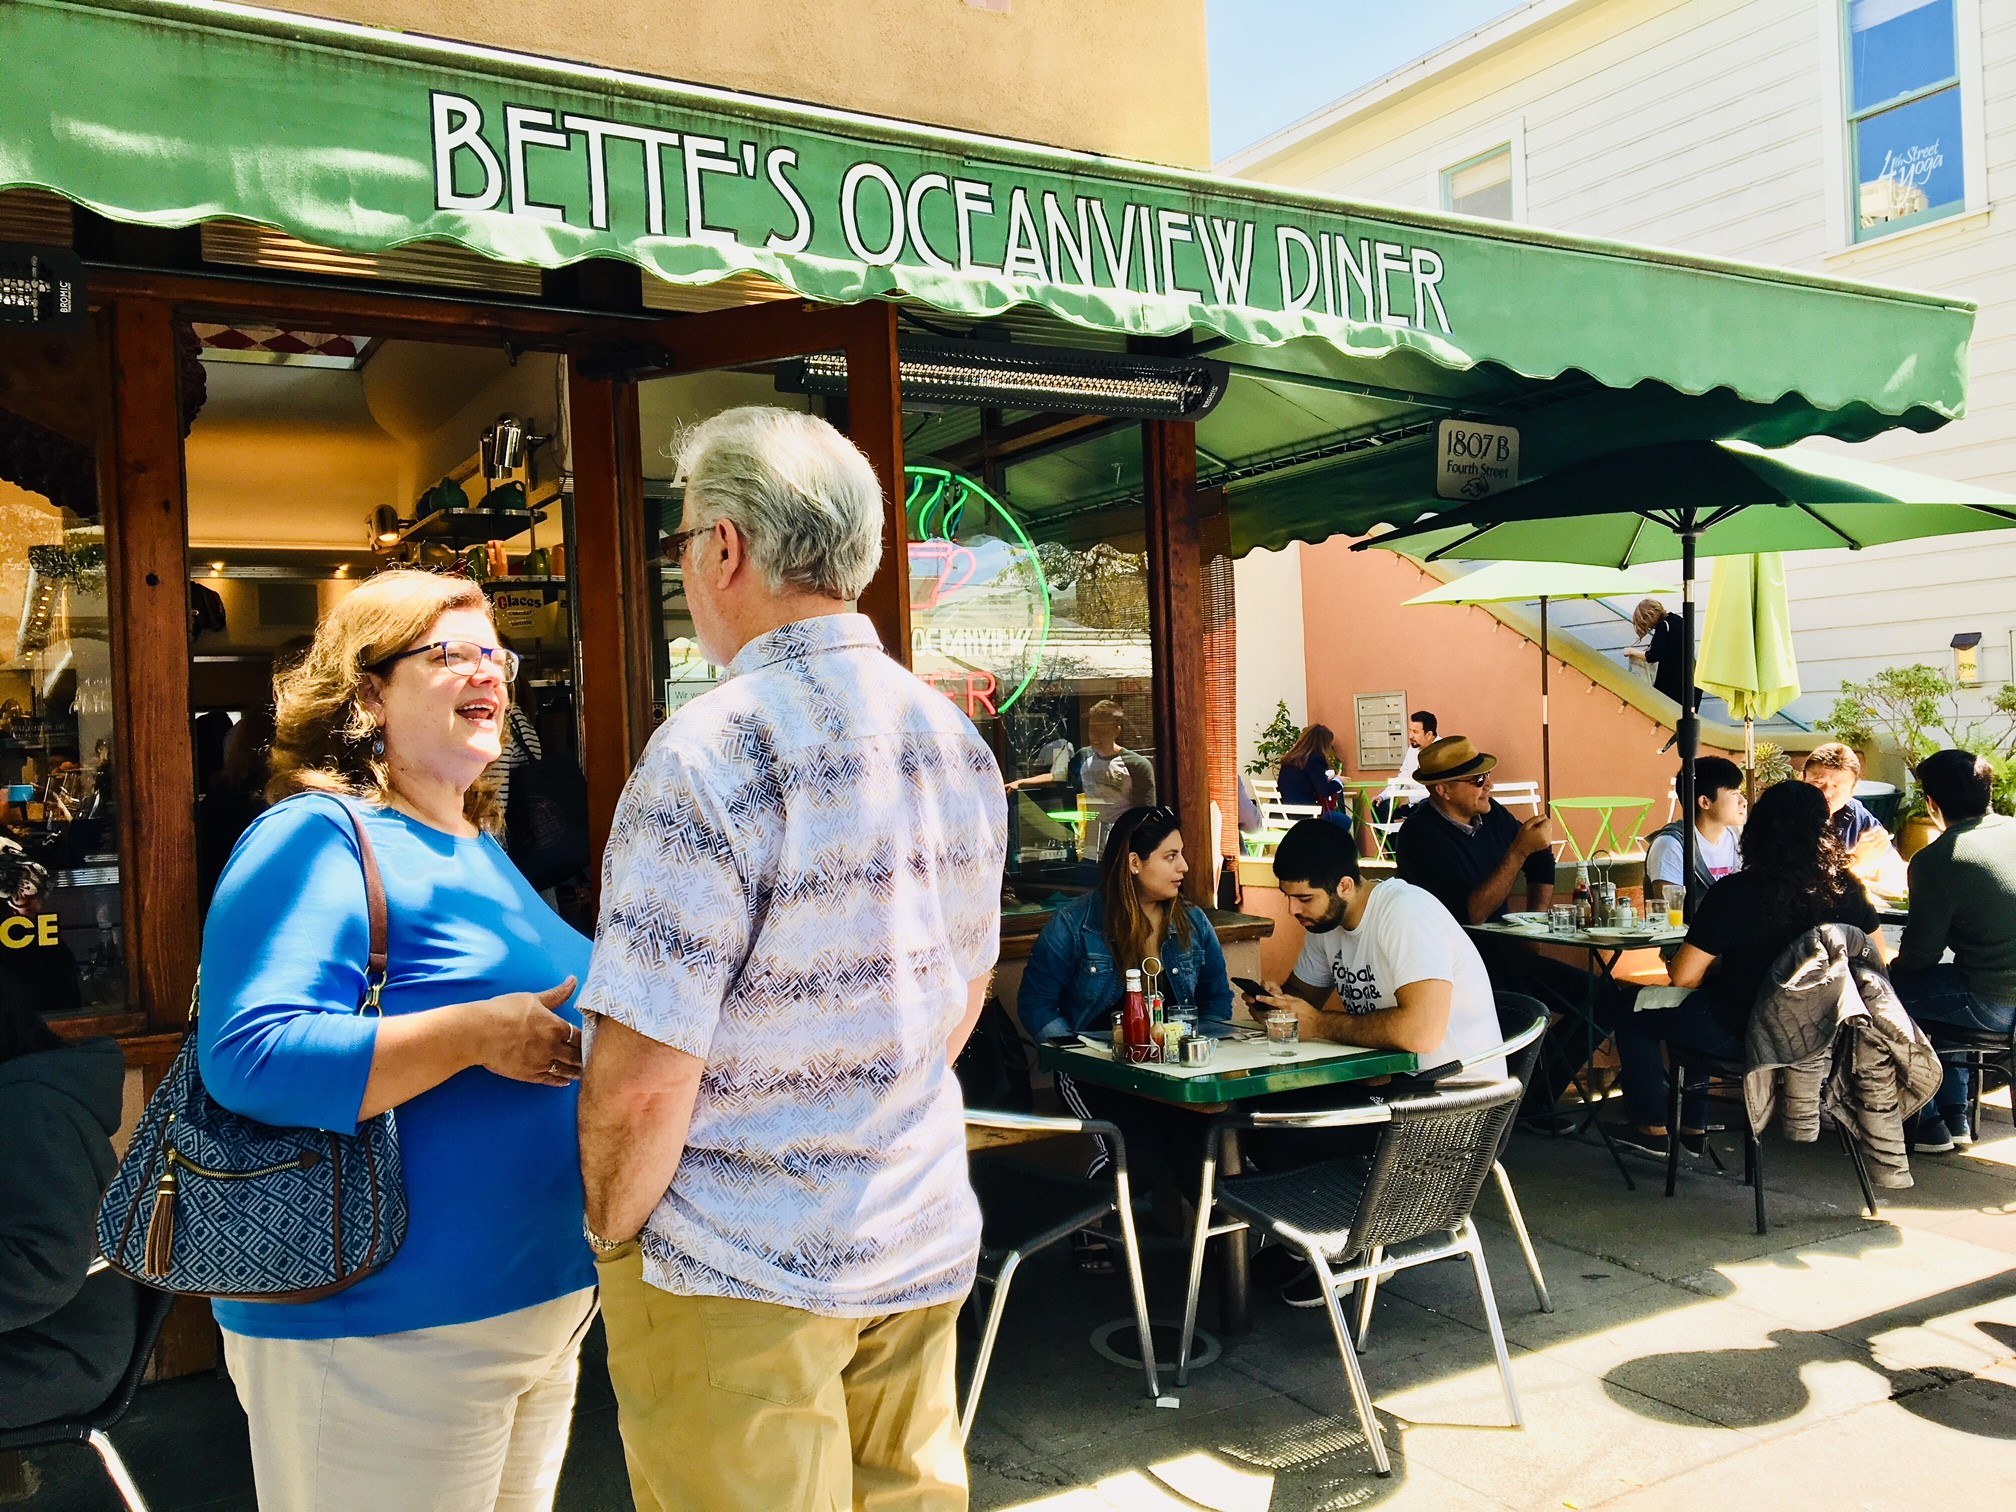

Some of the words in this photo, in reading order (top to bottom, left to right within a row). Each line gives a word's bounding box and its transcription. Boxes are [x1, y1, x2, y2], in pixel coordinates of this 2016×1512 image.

[1903, 138, 1940, 165] Street
[1892, 154, 1944, 208] Yoga
[429, 89, 815, 252] BETTE'S
[839, 160, 1256, 306] OCEANVIEW
[1275, 224, 1453, 335] DINER
[60, 280, 68, 313] BROMIC
[1447, 429, 1495, 460] 1807
[1447, 459, 1479, 475] Fourth
[1480, 462, 1509, 478] Street
[497, 594, 542, 609] Glaces
[911, 627, 1033, 657] OCEANVIEW
[0, 913, 59, 949] CE
